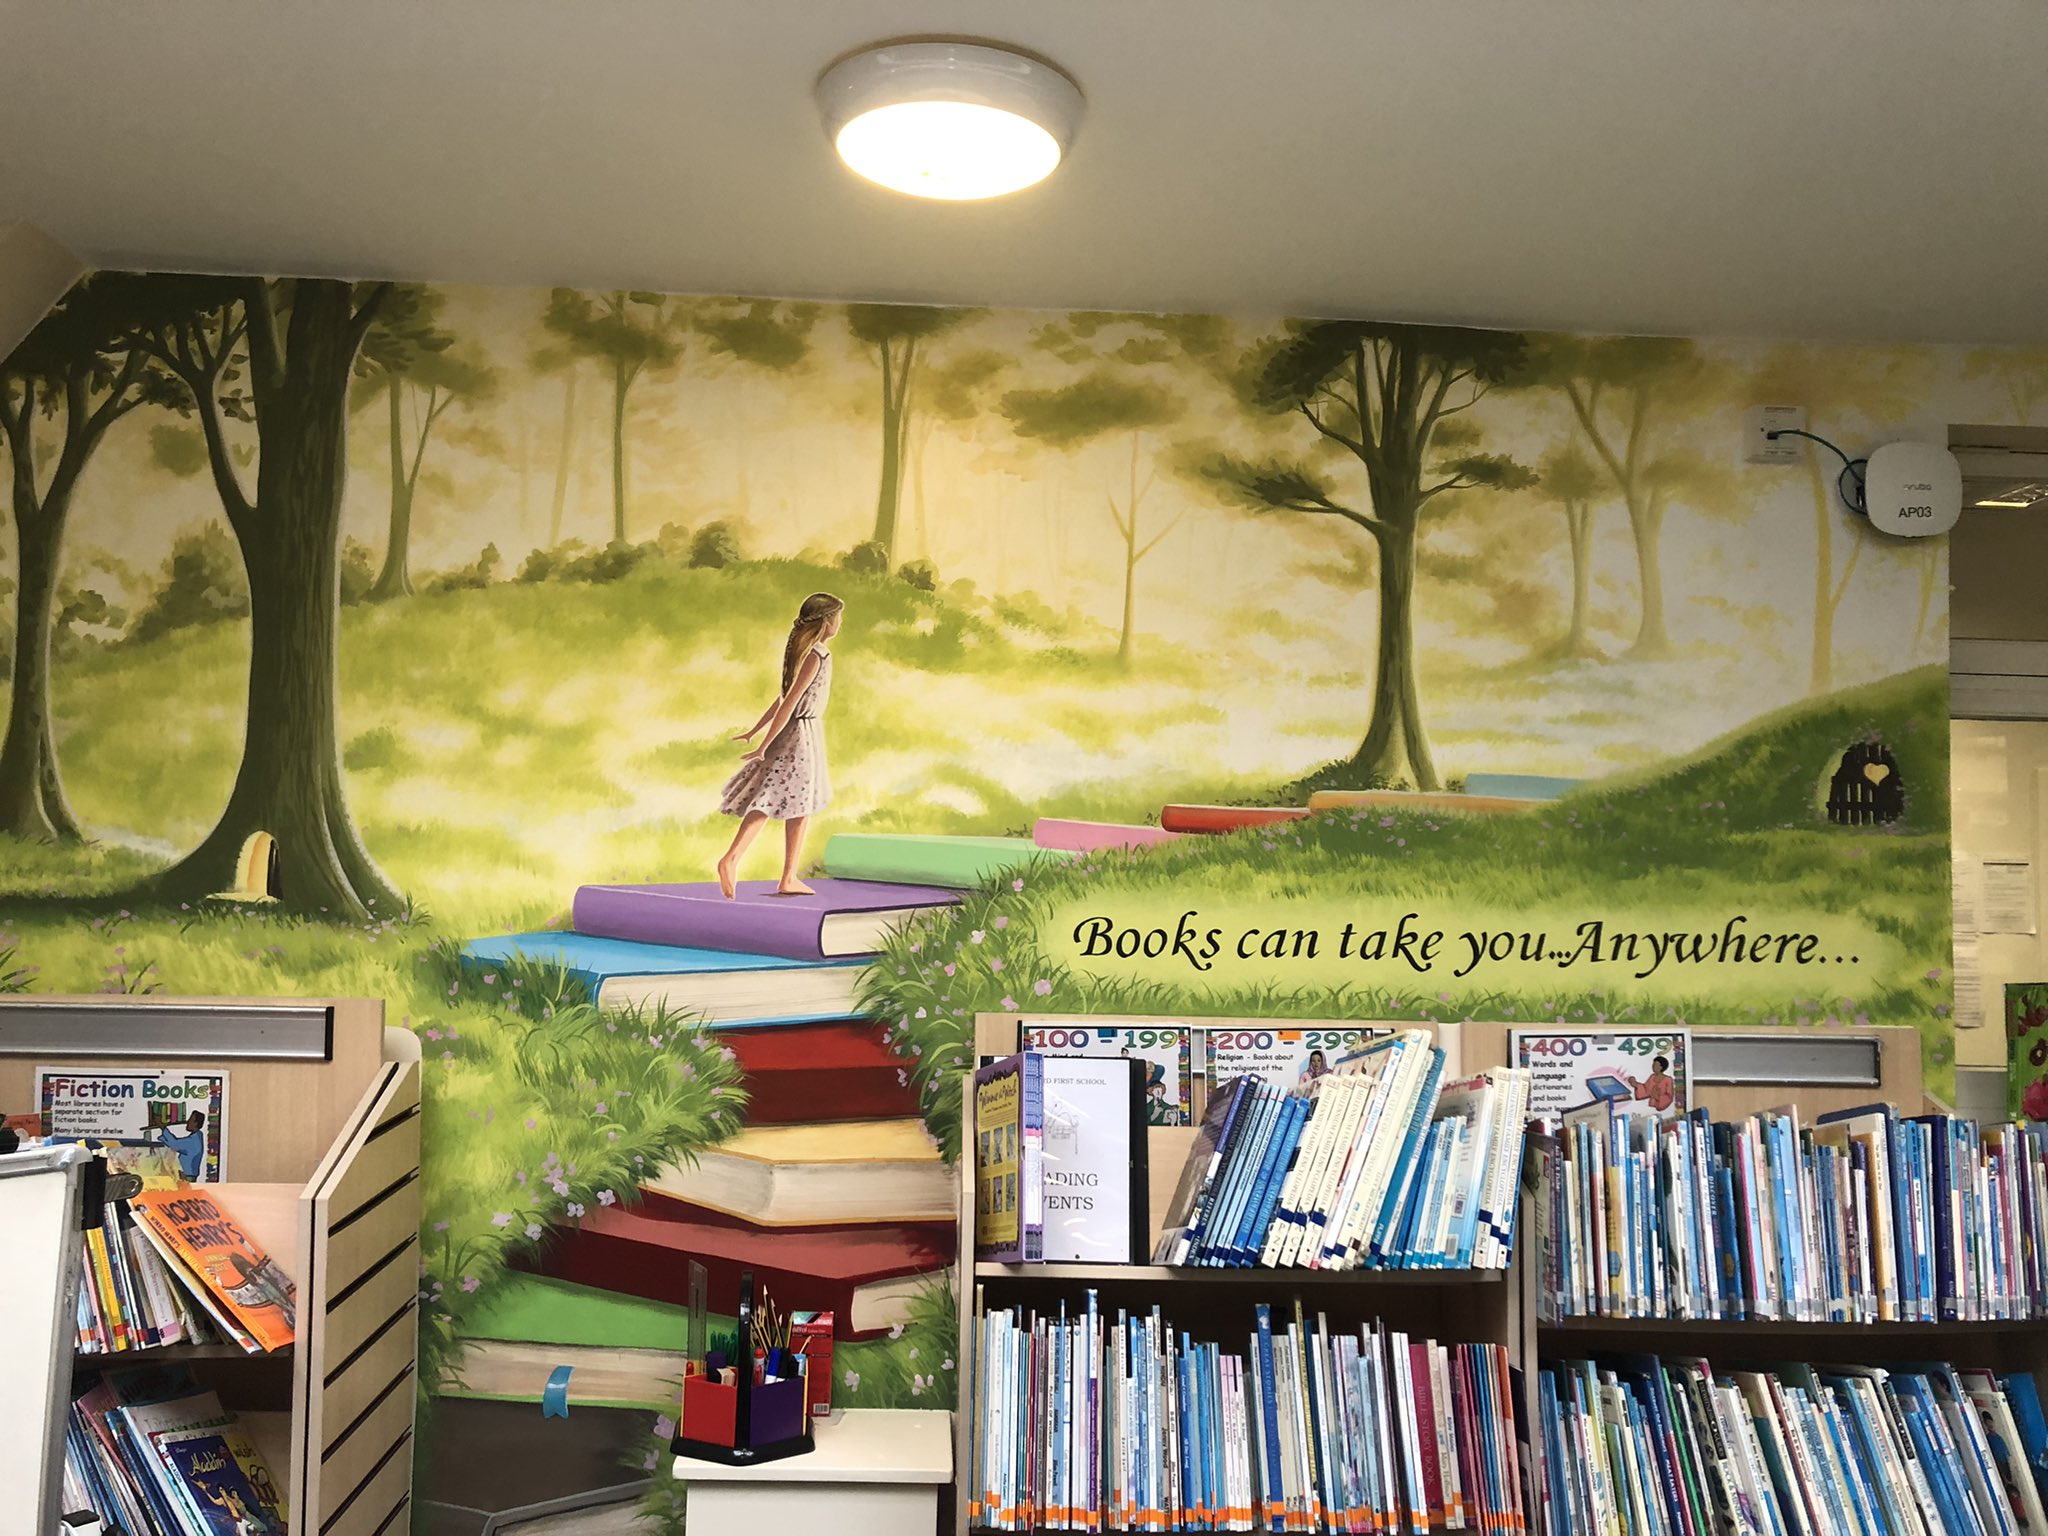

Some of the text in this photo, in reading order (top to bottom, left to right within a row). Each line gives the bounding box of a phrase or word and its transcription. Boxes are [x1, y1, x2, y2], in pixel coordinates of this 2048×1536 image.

[1899, 507, 1932, 518] AP03
[1074, 911, 1221, 970] Books
[1238, 930, 1317, 959] can
[1340, 914, 1443, 973] take
[1035, 1030, 1089, 1049] 100
[1125, 1030, 1179, 1049] 199
[1217, 1031, 1273, 1050] 200
[1305, 1031, 1361, 1051] 299
[1532, 1038, 1587, 1057] 400
[1618, 1038, 1673, 1056] 499
[1217, 1053, 1244, 1063] Religion
[1253, 1053, 1273, 1061] Books
[1275, 1053, 1294, 1061] about
[1217, 1064, 1283, 1074] the religions of the
[54, 1078, 209, 1100] Fiction Books
[1076, 1078, 1107, 1086] SCHOOL
[1532, 1073, 1567, 1081] Language
[1532, 1083, 1573, 1091] dictionaries
[73, 1100, 101, 1108] libraries
[1547, 1094, 1567, 1102] books
[54, 1109, 84, 1117] separate
[54, 1116, 77, 1124] fiction
[53, 1127, 124, 1136] Many libraries shelve
[1304, 1131, 1317, 1155] FAMILY
[1321, 1131, 1334, 1155] FAMILY
[1337, 1131, 1350, 1156] FAMILY
[1491, 1126, 1499, 1151] FAMILY
[1503, 1129, 1511, 1152] FAMILY
[1513, 1128, 1521, 1151] FAMILY
[1043, 1172, 1099, 1187] ADING
[1286, 1156, 1308, 1206] ENCYCLOPEDIA
[1304, 1155, 1325, 1206] ENCYCLOPEDIA
[1320, 1157, 1342, 1206] ENCYCLOPEDIA
[1483, 1152, 1496, 1204] ENCYCLOPEDIA
[1496, 1155, 1508, 1206] ENCYCLOPEDIA
[1506, 1154, 1518, 1205] ENCYCLOPEDIA
[1708, 1175, 1716, 1215] DISCOVER
[157, 1198, 221, 1227] HORRID
[149, 1214, 201, 1270] HORRID HENRY'S ANNUAL
[177, 1222, 245, 1252] HENRY'S
[1417, 1385, 1435, 1485] BIBLE STORY BOOK
[1436, 1410, 1444, 1427] Book
[1440, 1452, 1448, 1468] Mary
[1836, 1420, 1846, 1441] FLIGHT
[1649, 1387, 1659, 1411] Discover
[1657, 1423, 1667, 1452] Dinosaurs
[1665, 1458, 1673, 1477] MEAT
[1669, 1478, 1678, 1501] EATERS
[168, 1462, 183, 1483] ALADDIN
[188, 1450, 227, 1477] Aladdin
[1589, 1462, 1597, 1492] SEASHORE?
[1910, 1461, 1929, 1499] WEATHER
[1721, 1461, 1732, 1482] ROCK
[1730, 1491, 1745, 1526] MINERAL
